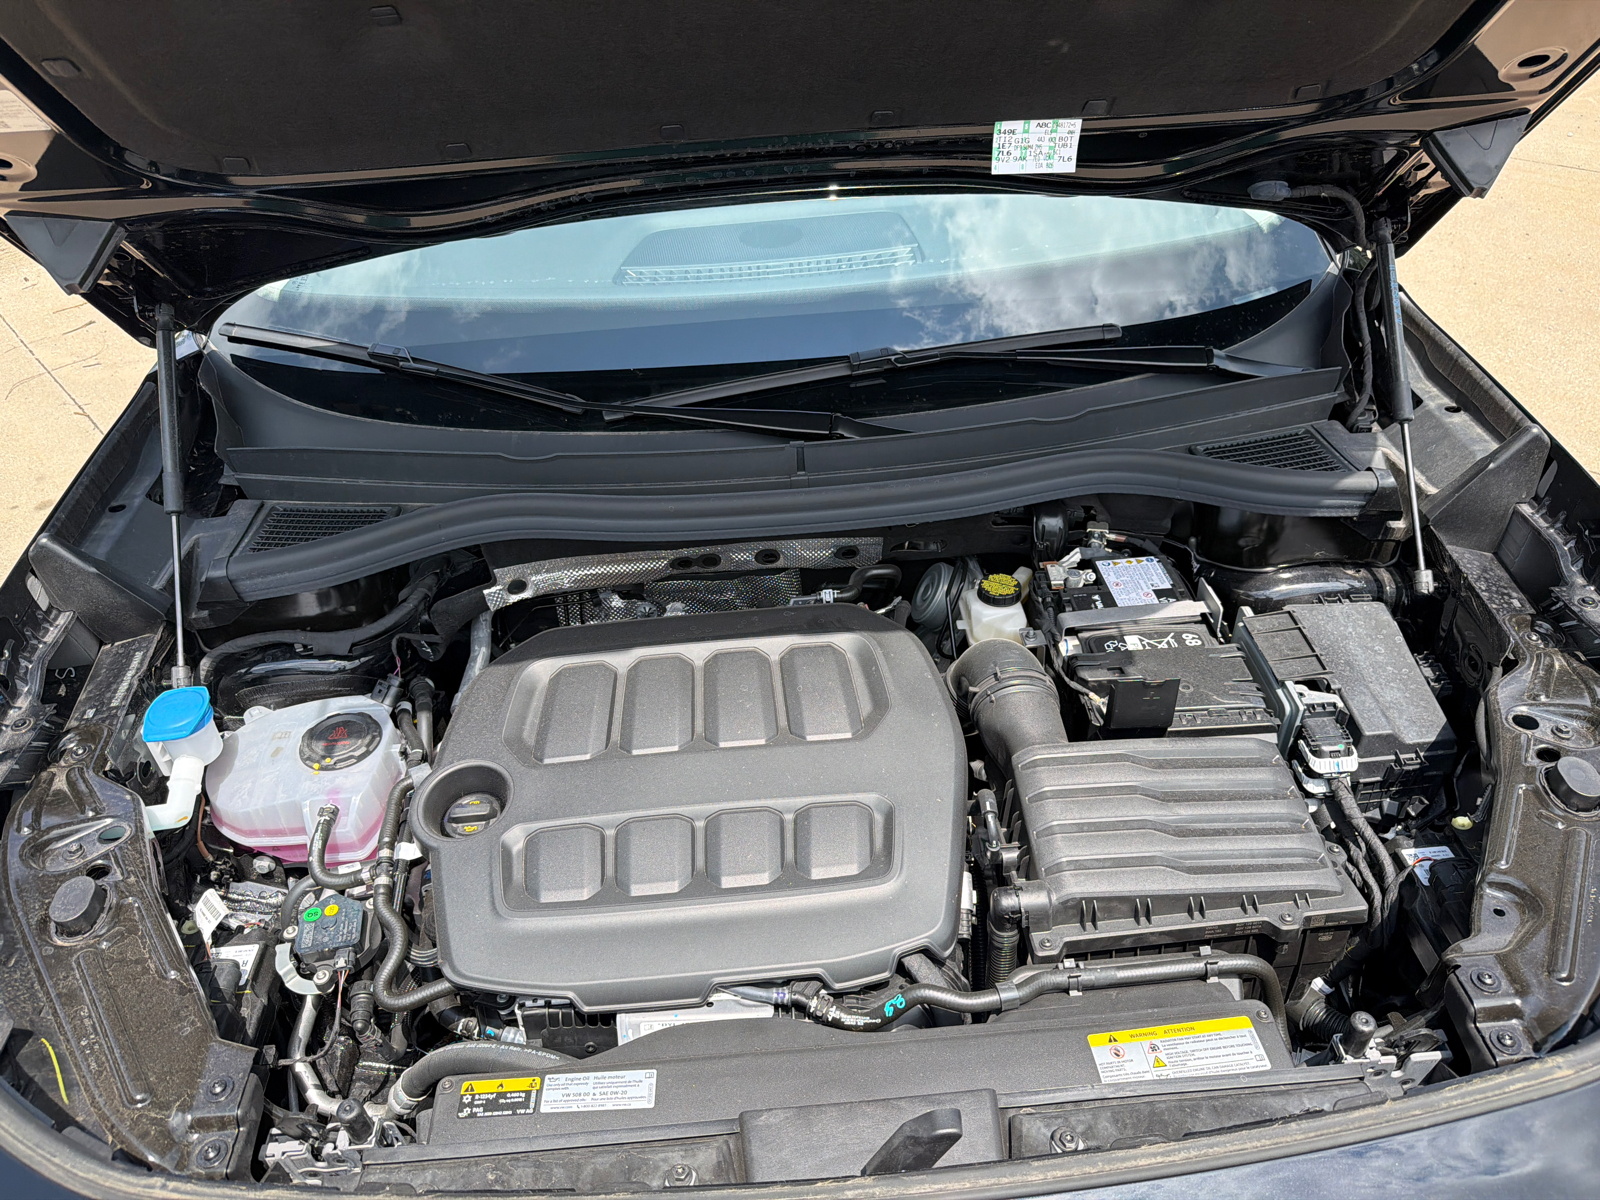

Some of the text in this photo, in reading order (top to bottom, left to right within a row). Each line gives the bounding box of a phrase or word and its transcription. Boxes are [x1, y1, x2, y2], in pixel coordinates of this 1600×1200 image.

[1182, 633, 1202, 647] 68
[1129, 1026, 1196, 1039] WARNING ATTENTION
